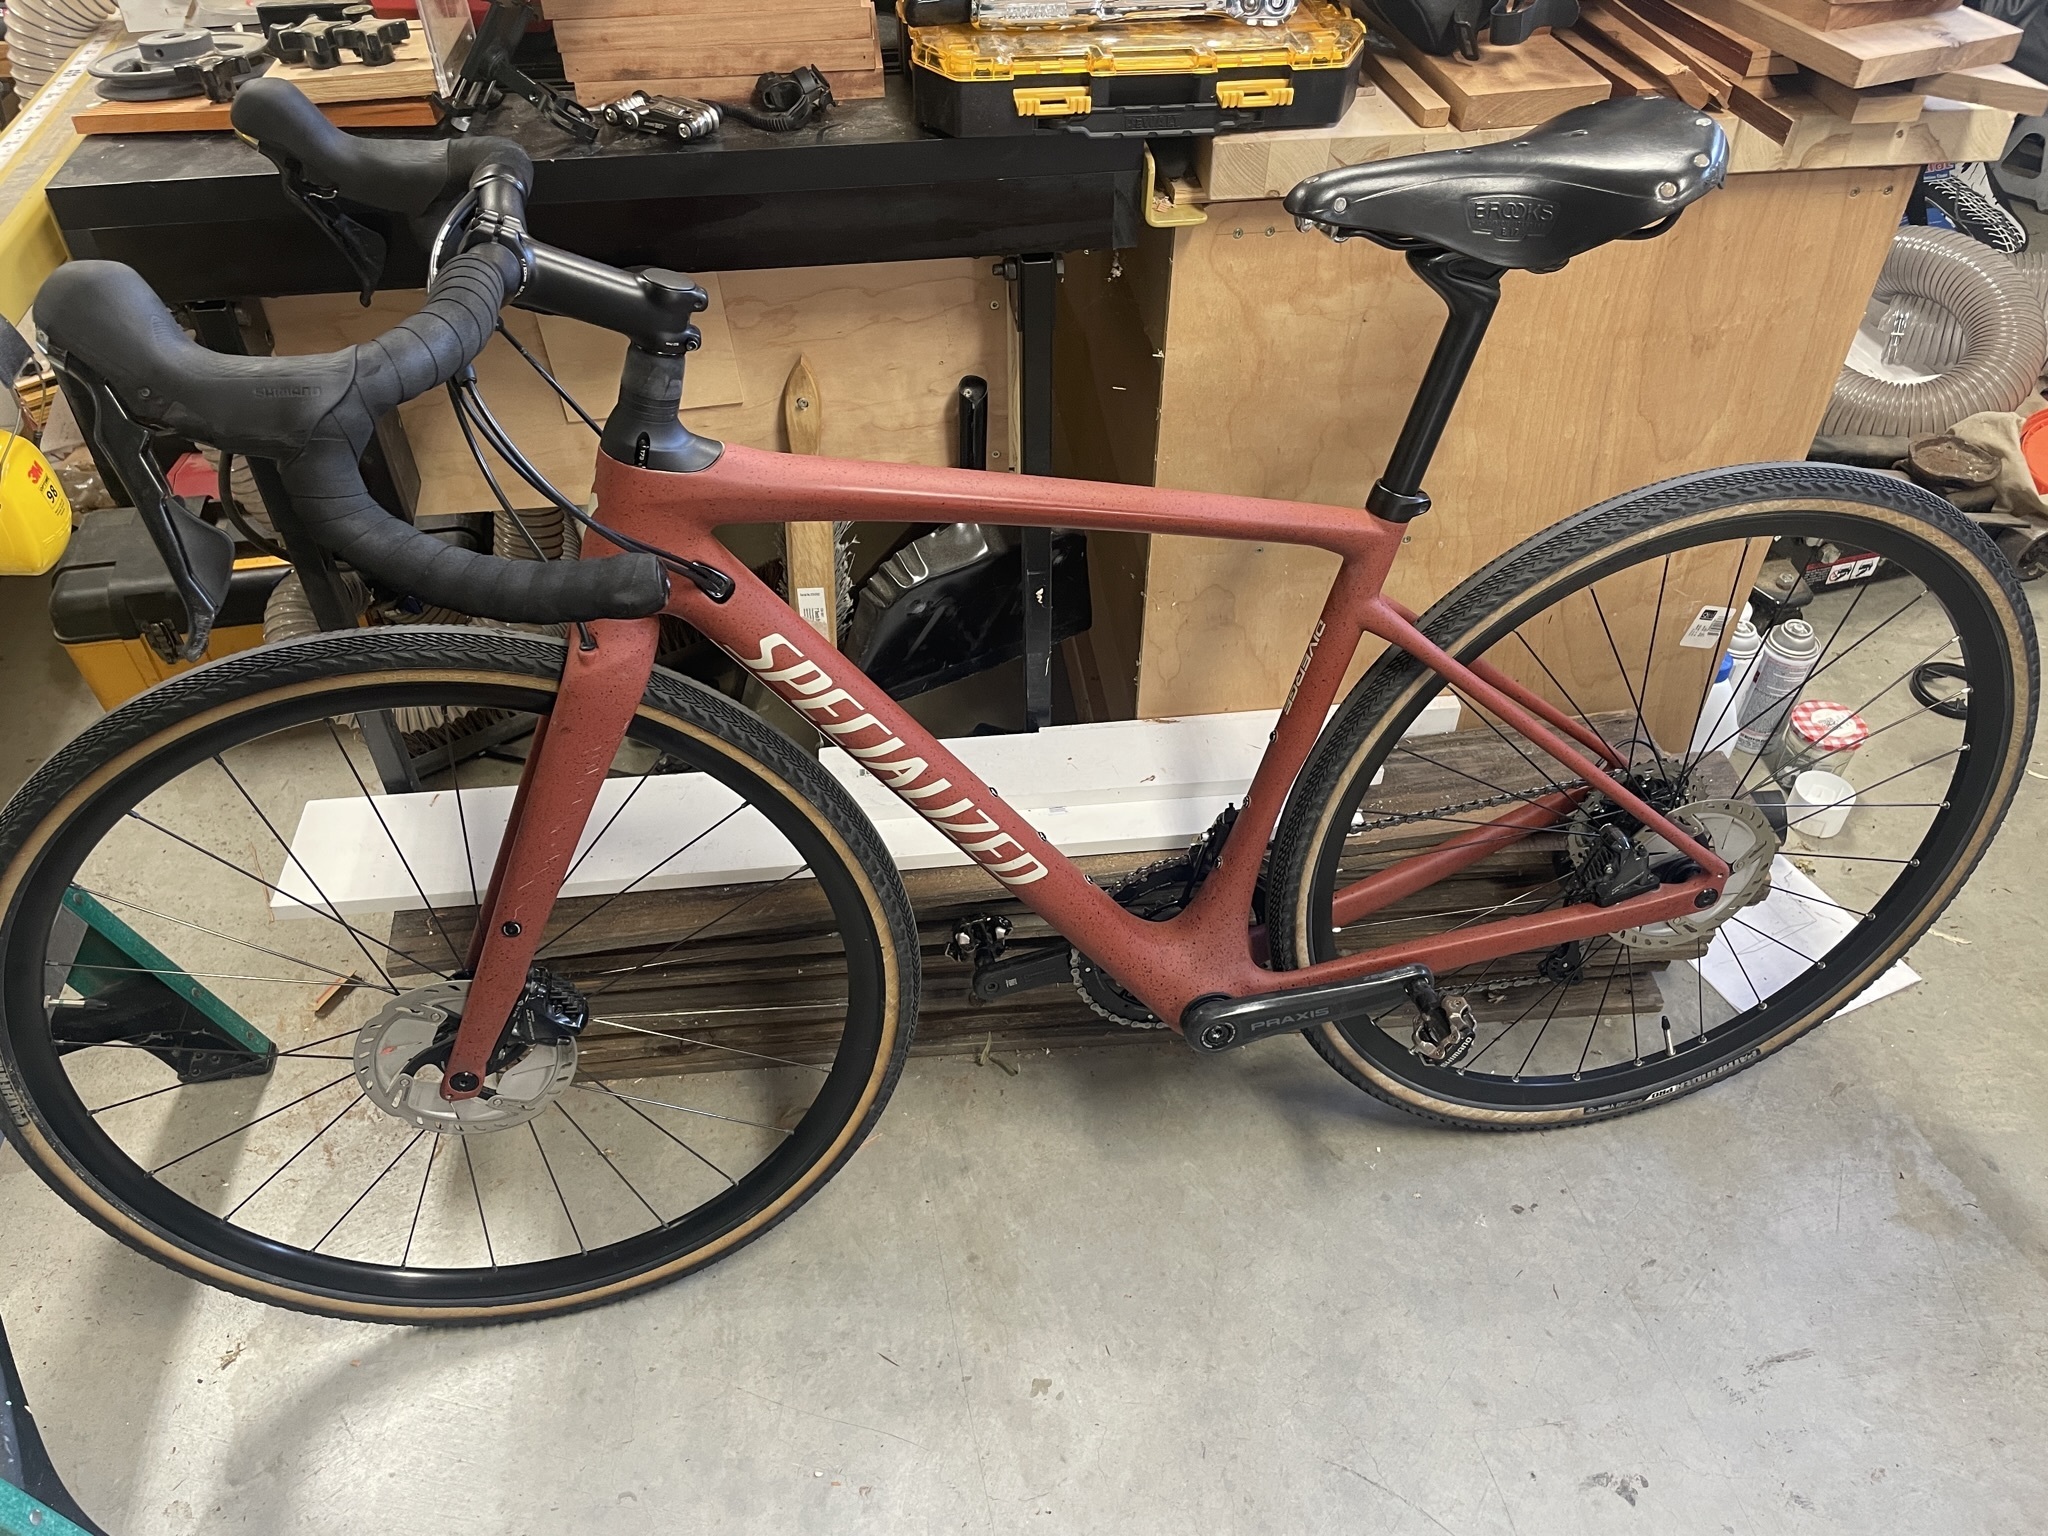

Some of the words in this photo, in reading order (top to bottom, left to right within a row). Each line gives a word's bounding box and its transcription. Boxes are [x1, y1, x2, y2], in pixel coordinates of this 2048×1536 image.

[1474, 201, 1554, 221] BROOKS
[27, 460, 44, 485] 3M
[46, 485, 58, 504] 98
[1284, 618, 1327, 716] DIVERGE
[743, 632, 1049, 886] SPECIALIZED
[1250, 1006, 1330, 1032] PRAXIS
[1439, 1036, 1473, 1068] SHIMANO
